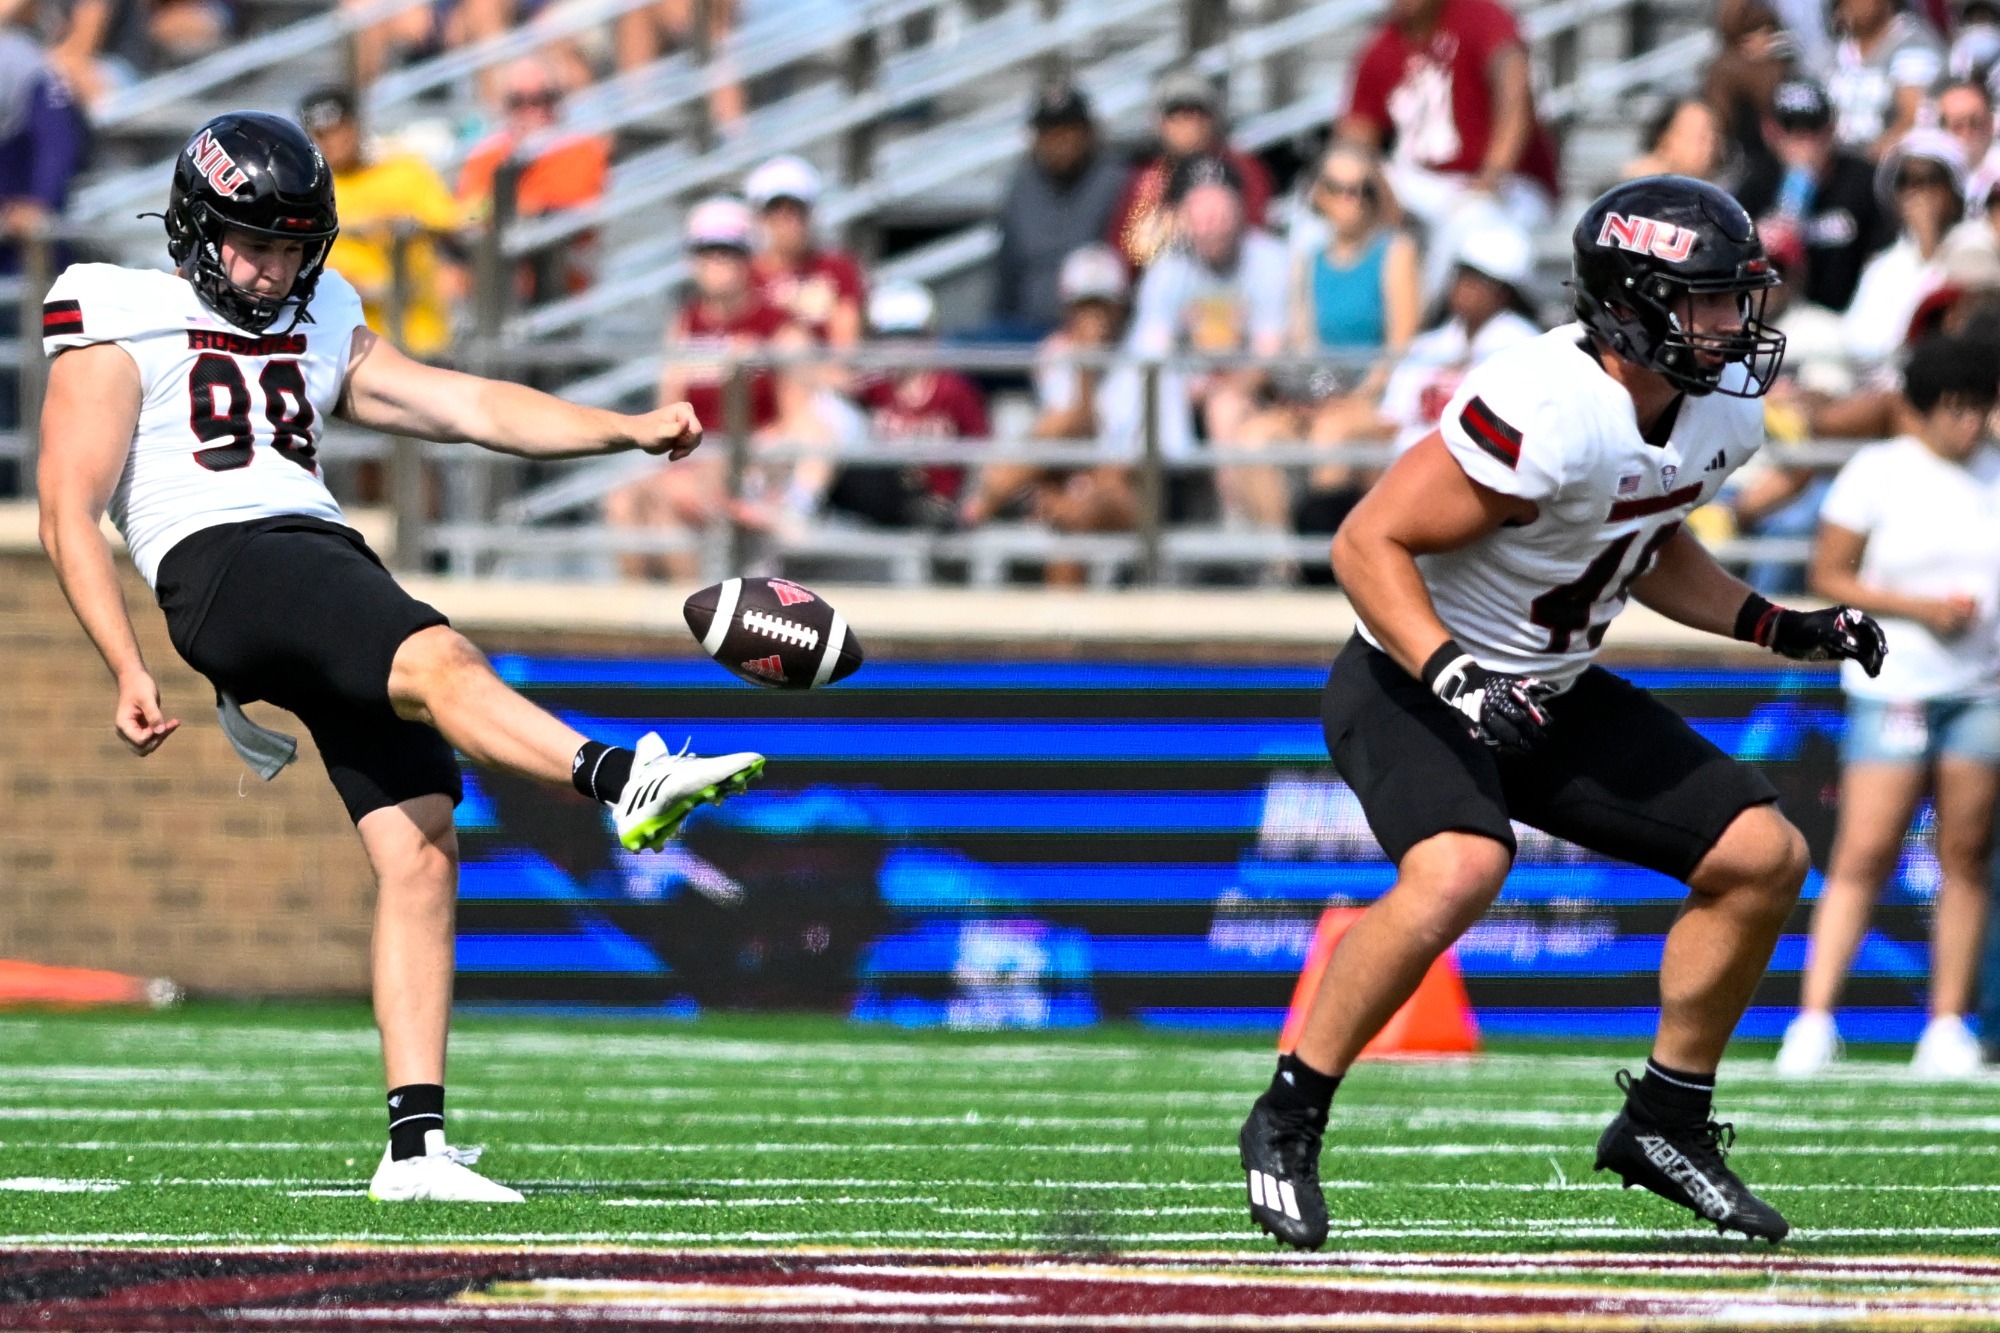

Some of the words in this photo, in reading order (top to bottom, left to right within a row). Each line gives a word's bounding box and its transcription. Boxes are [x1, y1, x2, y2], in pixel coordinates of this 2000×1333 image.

[187, 128, 249, 197] NIU
[1596, 211, 1697, 263] NIU
[189, 352, 318, 476] 98
